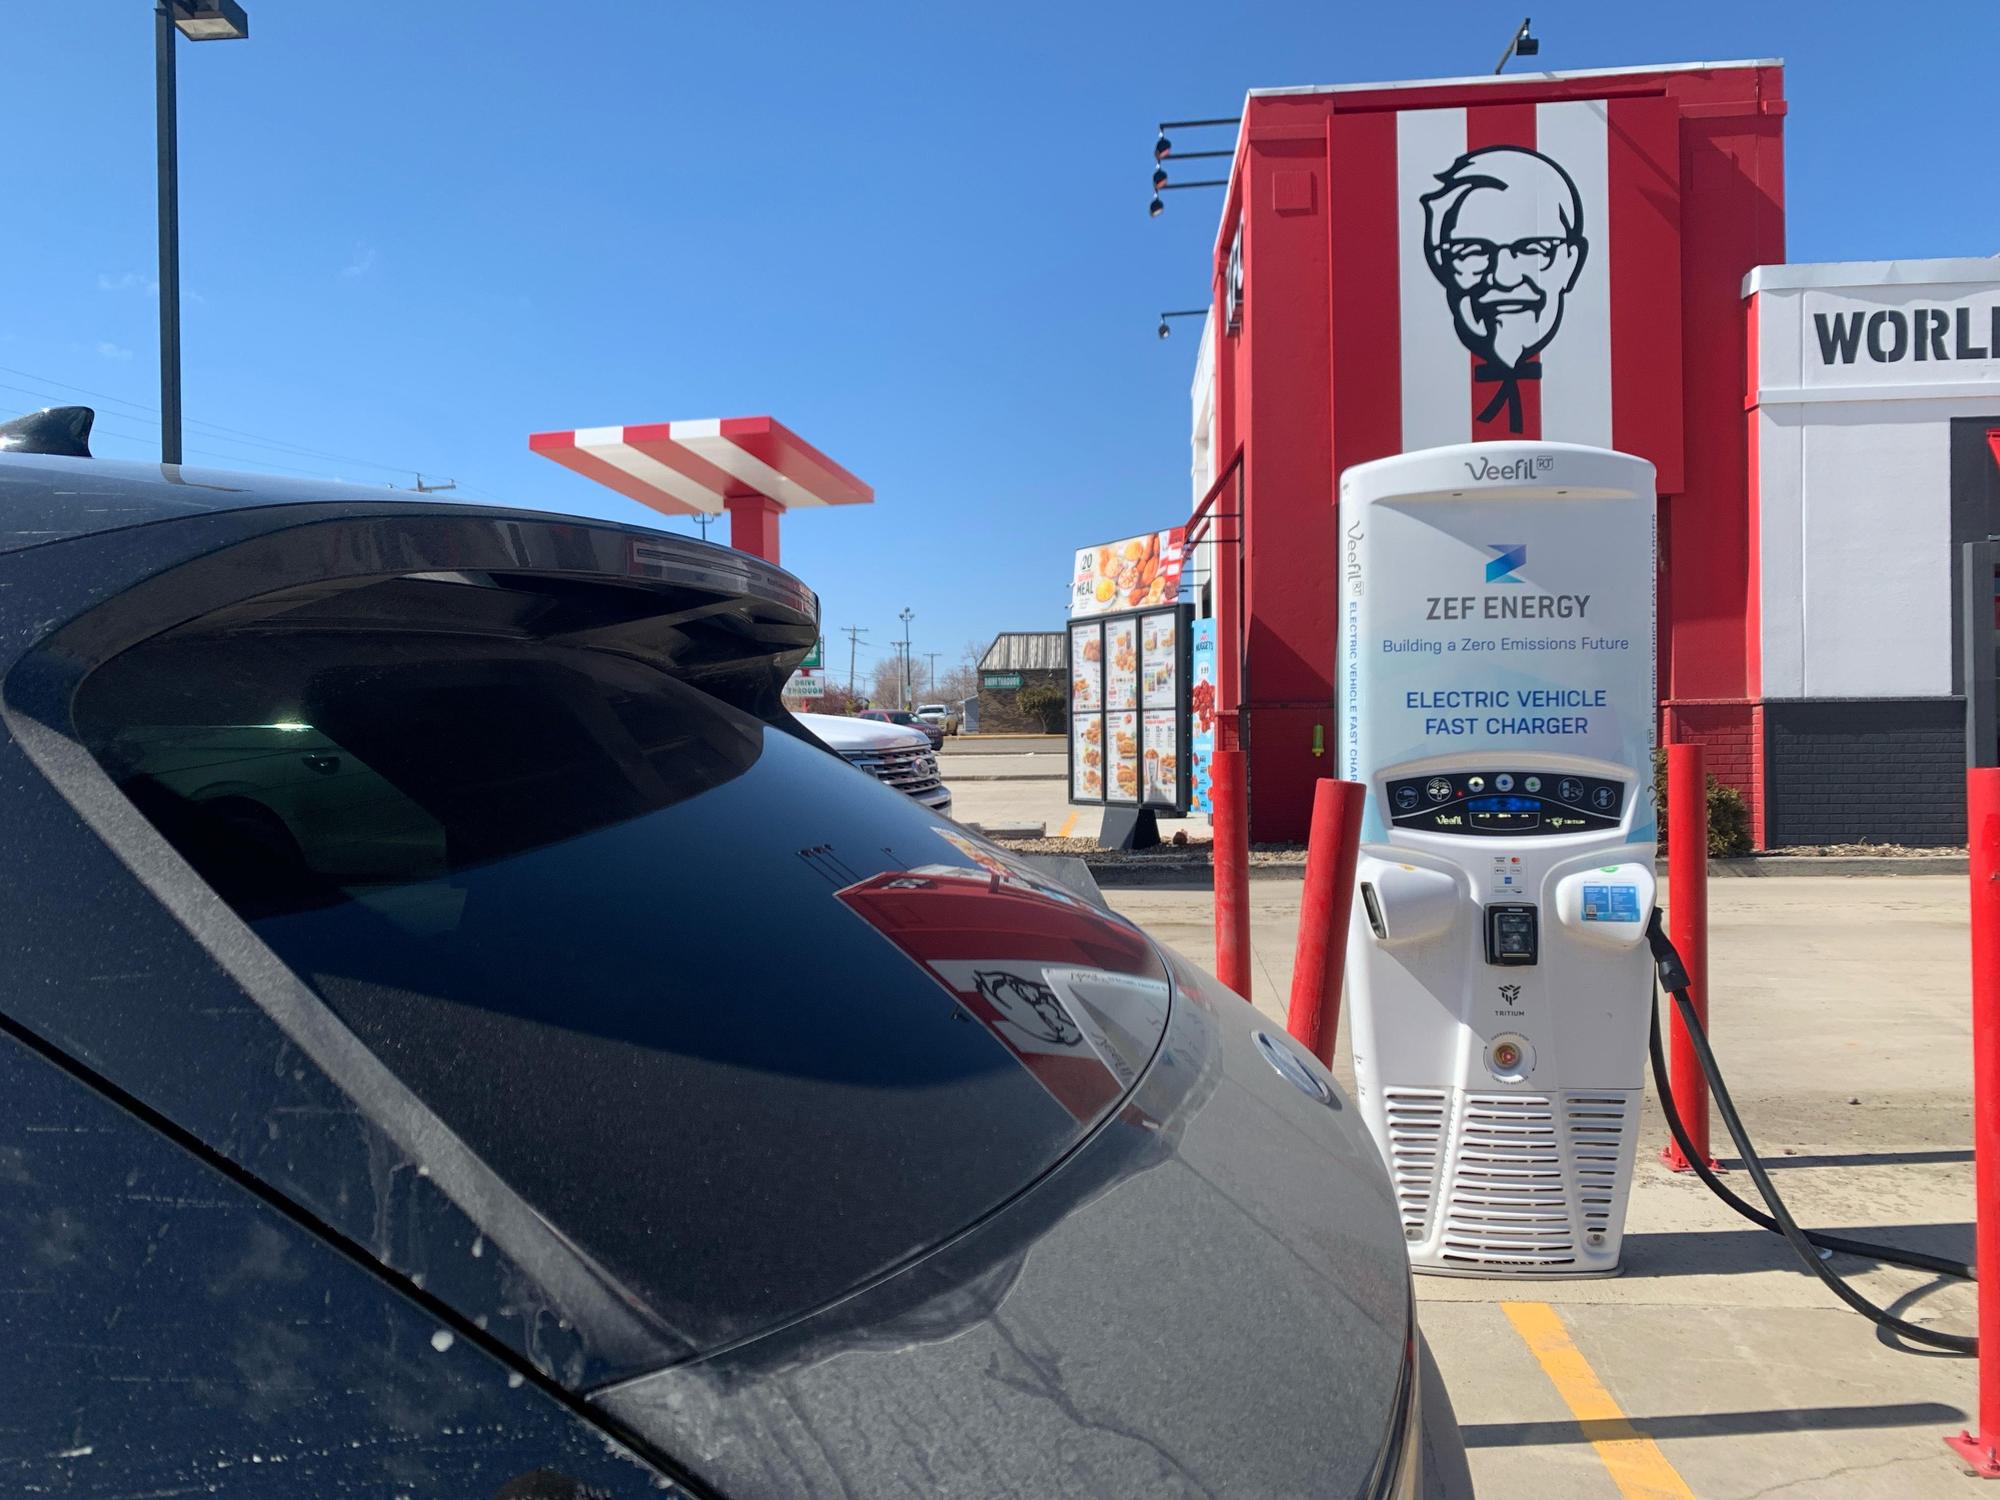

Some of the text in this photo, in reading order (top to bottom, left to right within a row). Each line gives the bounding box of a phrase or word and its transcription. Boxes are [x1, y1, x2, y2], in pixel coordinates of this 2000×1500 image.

[1813, 306, 2000, 365] WORL
[1465, 456, 1537, 480] Veefil
[1347, 520, 1364, 582] Veefil
[1077, 581, 1093, 596] MEAL
[1426, 595, 1590, 620] ZEF ENERGY
[1349, 602, 1358, 659] ELECTRIC
[1383, 637, 1629, 655] Building a Zero Emissions Future
[1349, 663, 1358, 712] VEHICLE
[1407, 690, 1607, 708] ELECTRIC VEHICLE
[1349, 716, 1358, 745] FAST
[1426, 717, 1588, 735] FAST CHARGER
